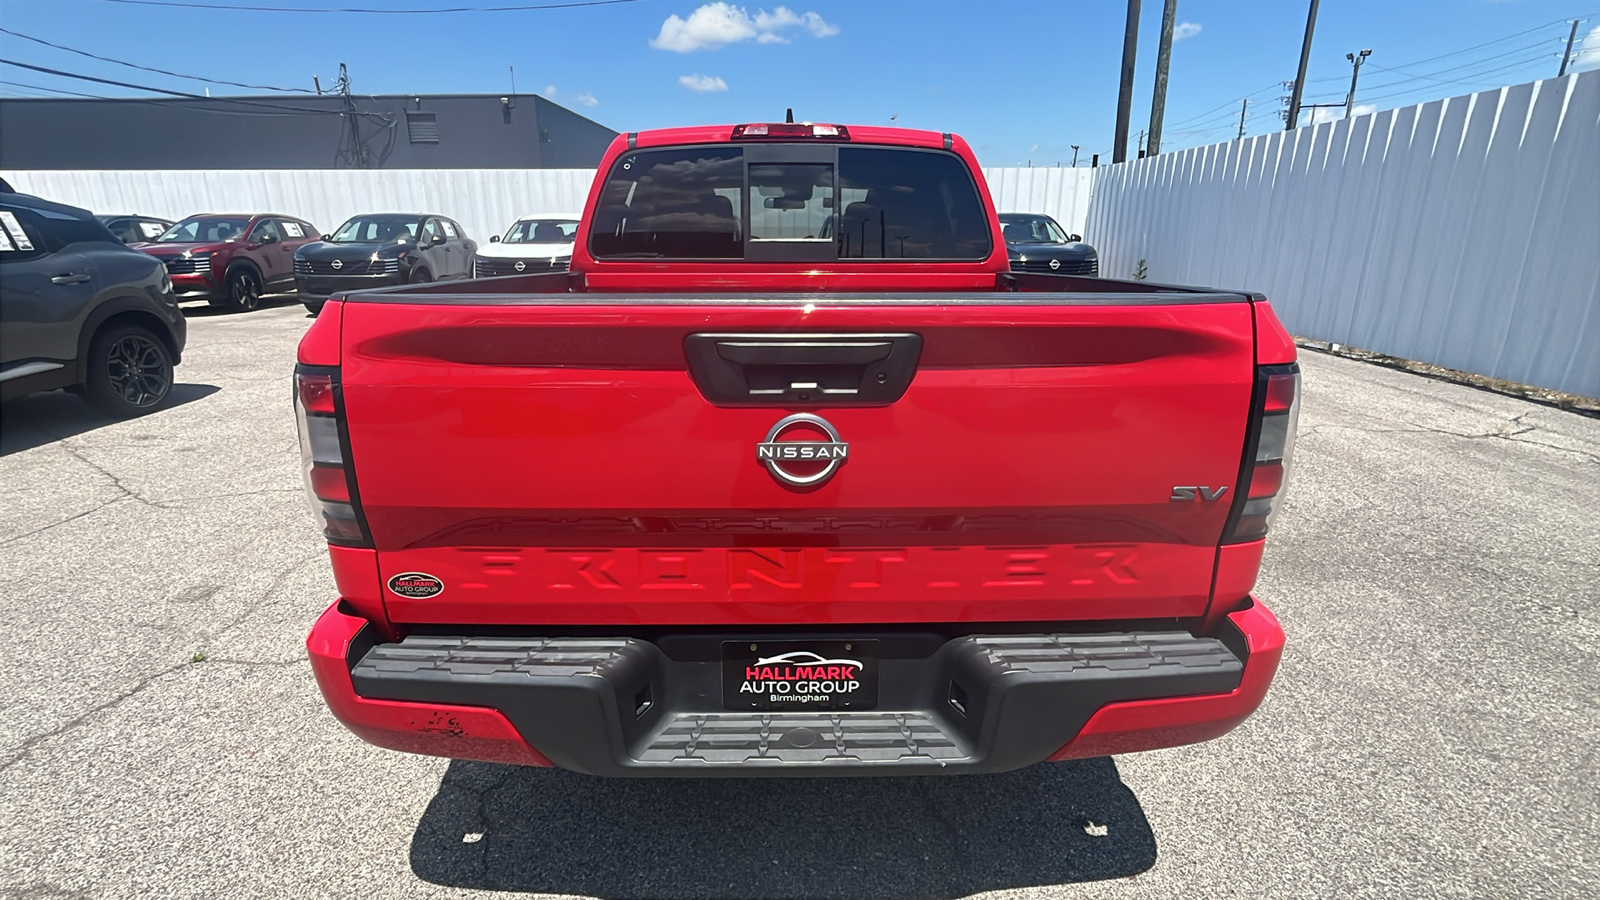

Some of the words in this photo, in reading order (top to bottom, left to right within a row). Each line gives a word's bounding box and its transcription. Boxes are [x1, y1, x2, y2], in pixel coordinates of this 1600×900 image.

[759, 446, 847, 458] NISSAN
[1170, 486, 1228, 501] SV
[455, 545, 1141, 590] FRONTIER
[745, 666, 854, 680] HALLMARK
[739, 680, 791, 693] AUTO
[795, 681, 860, 693] GROUP
[770, 694, 829, 703] Birmingham
